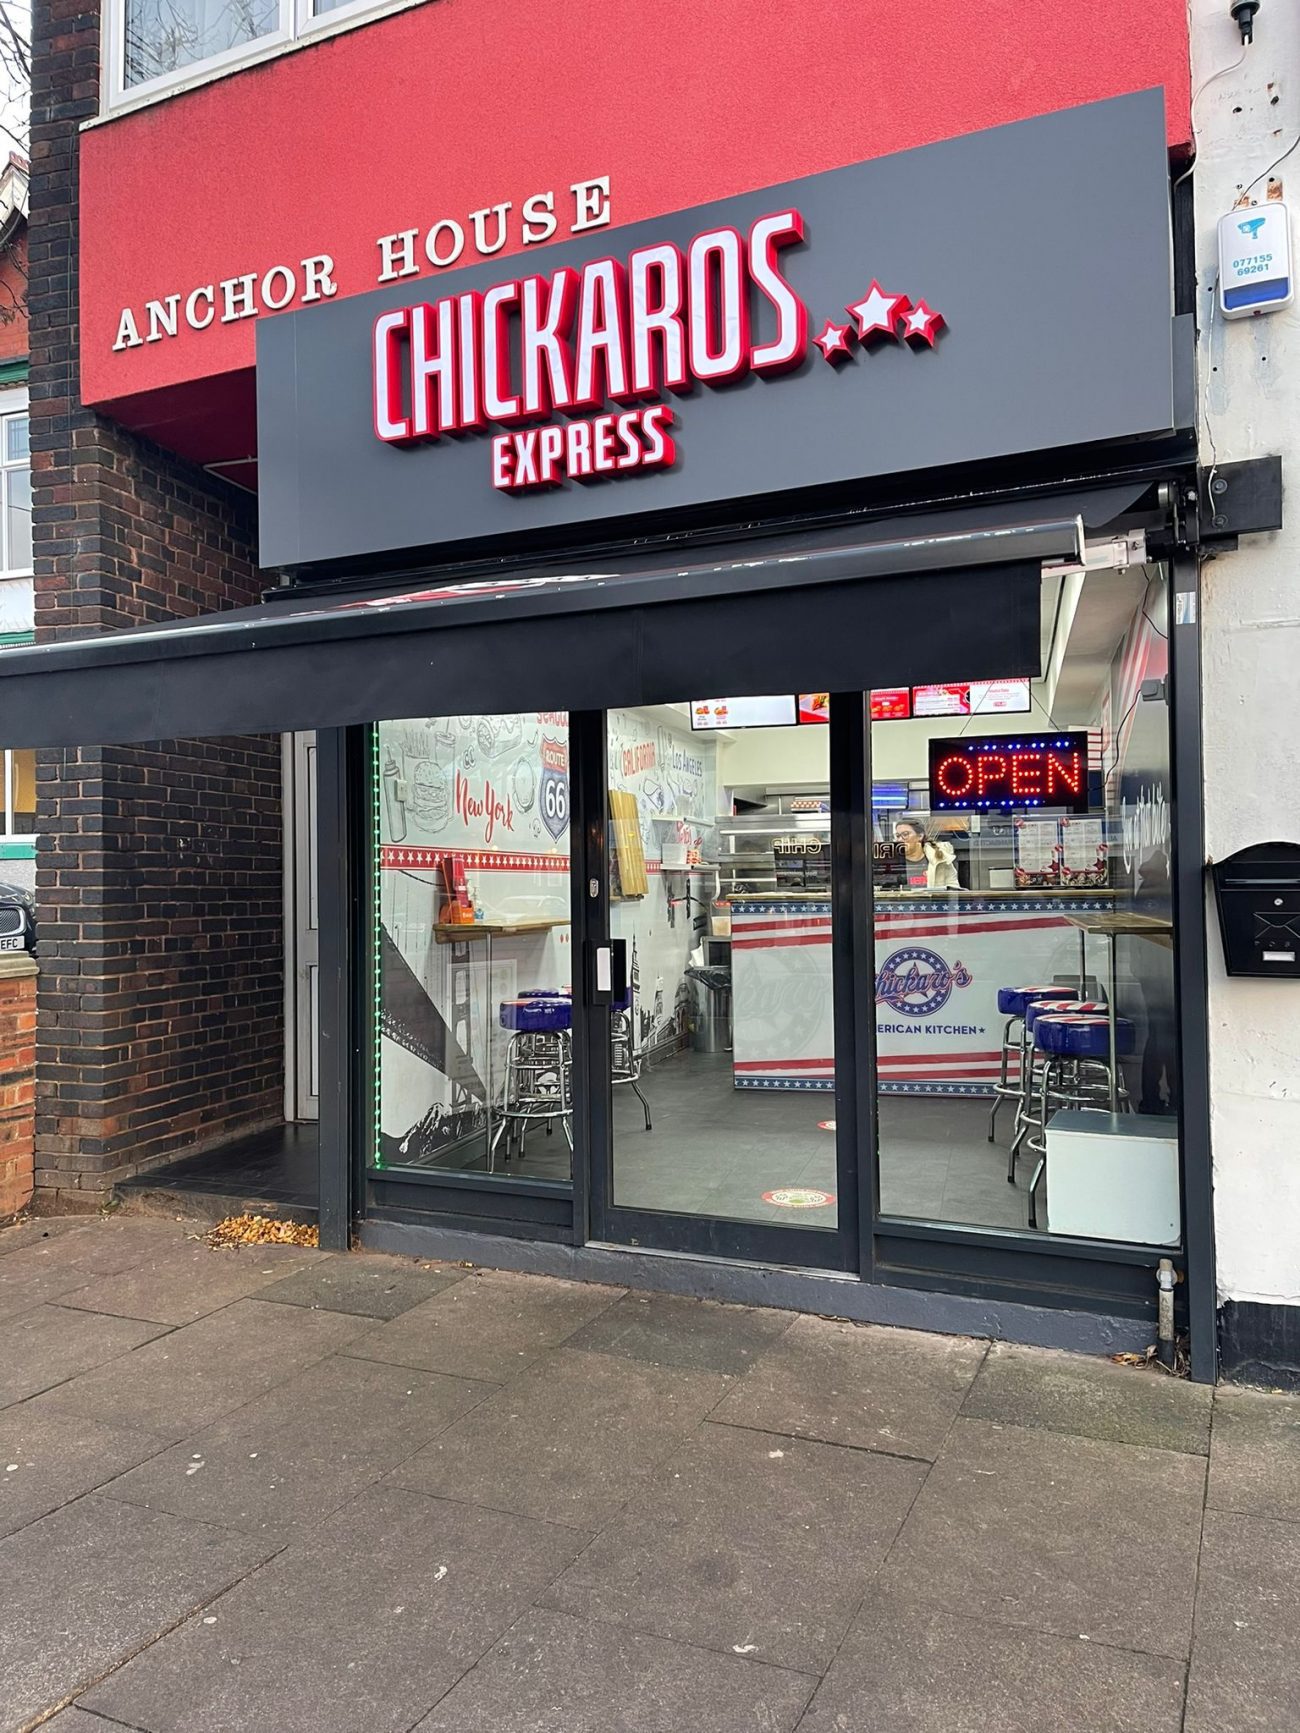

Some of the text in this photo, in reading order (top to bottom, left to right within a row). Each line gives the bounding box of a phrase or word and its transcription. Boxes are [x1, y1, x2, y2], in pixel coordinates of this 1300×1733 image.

[111, 175, 611, 351] ANCHOR HOUSE
[1232, 253, 1273, 268] 077155
[1237, 263, 1269, 276] 69261
[371, 207, 806, 448] CHICKAROS
[490, 403, 678, 495] EXPRESS
[545, 749, 565, 767] ROUTE
[937, 751, 1080, 796] OPEN
[485, 780, 515, 844] York
[545, 779, 566, 819] 66
[0, 938, 18, 950] EFC
[875, 960, 973, 1005] hickaro's
[877, 1023, 977, 1036] ERICAN KITCHEN
